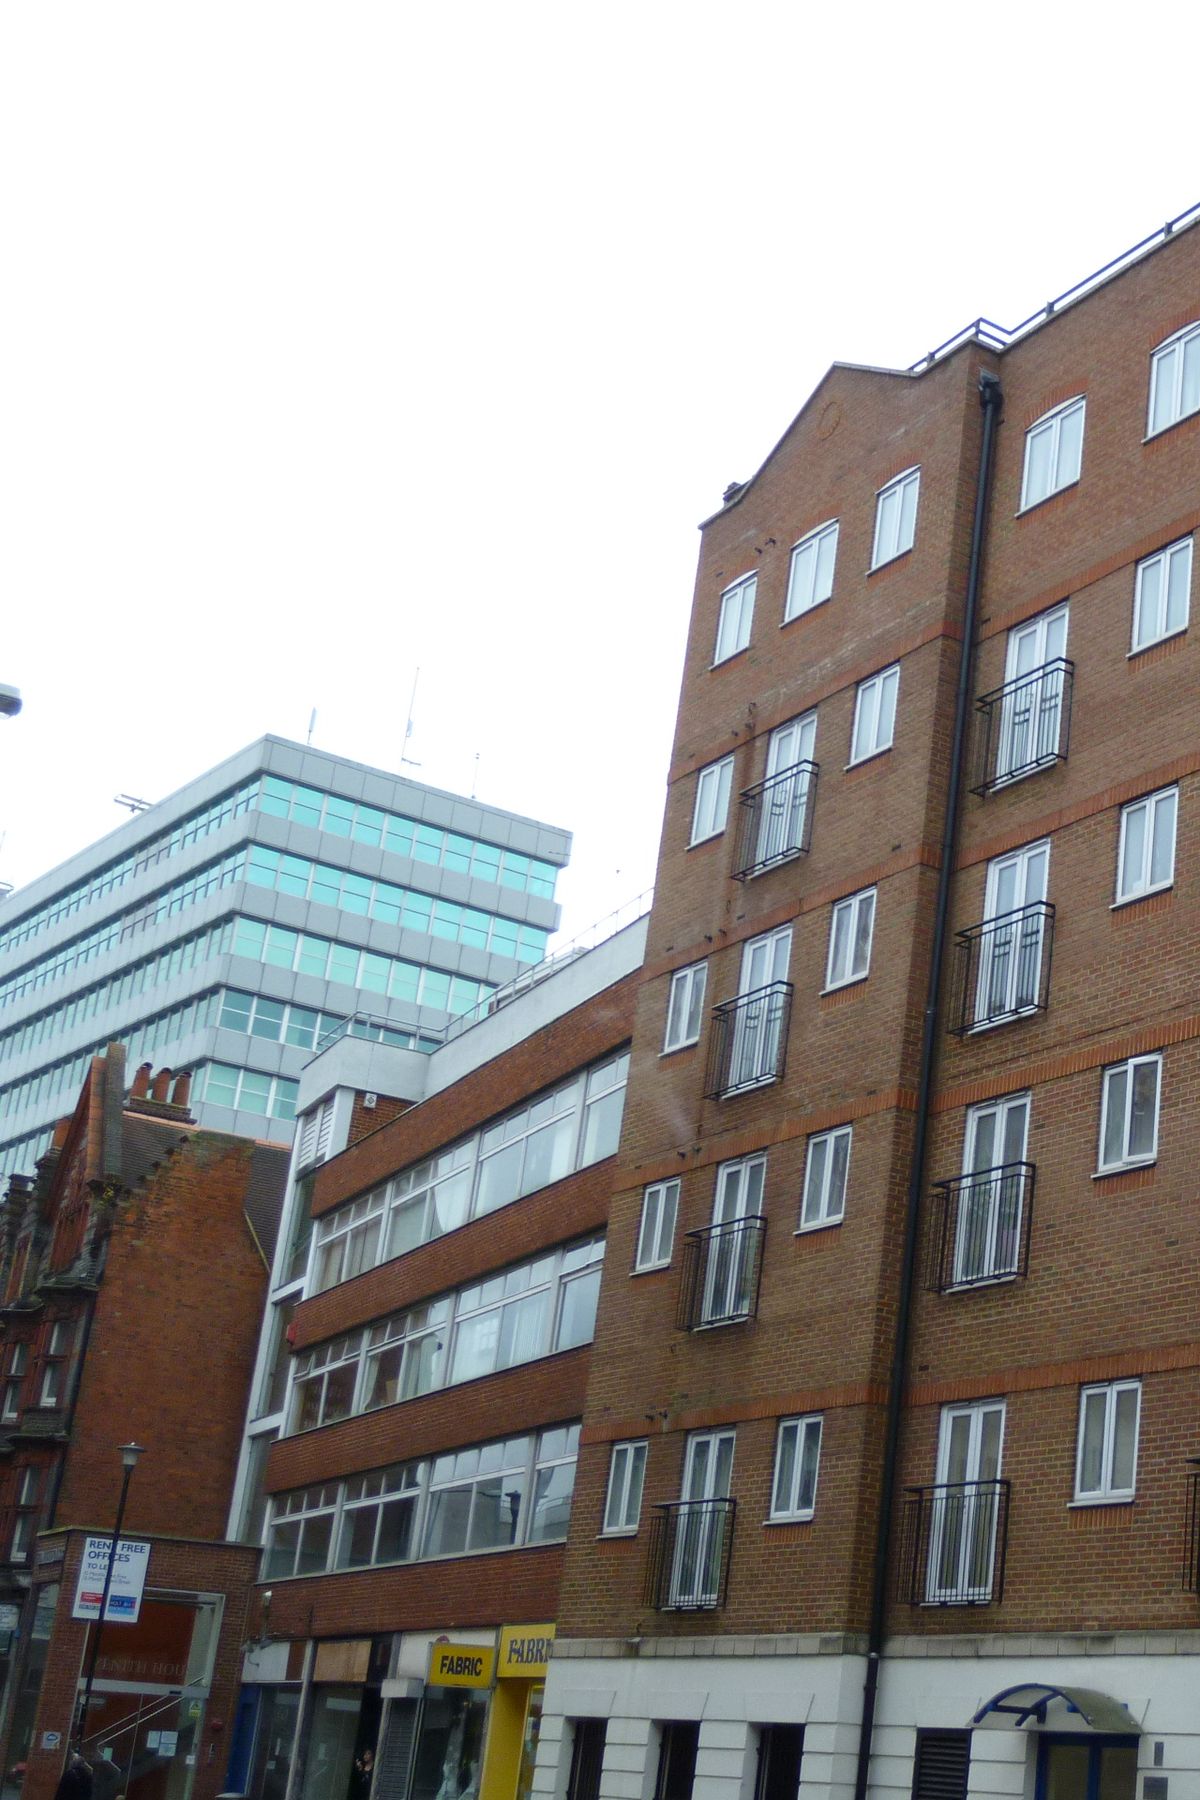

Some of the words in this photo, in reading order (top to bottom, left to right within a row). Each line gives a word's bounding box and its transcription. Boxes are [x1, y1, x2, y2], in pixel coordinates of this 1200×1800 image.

[89, 1539, 118, 1551] REN
[121, 1543, 146, 1554] FREE
[87, 1562, 98, 1570] TO
[507, 1637, 551, 1665] FABRI
[440, 1655, 483, 1677] FABRIC
